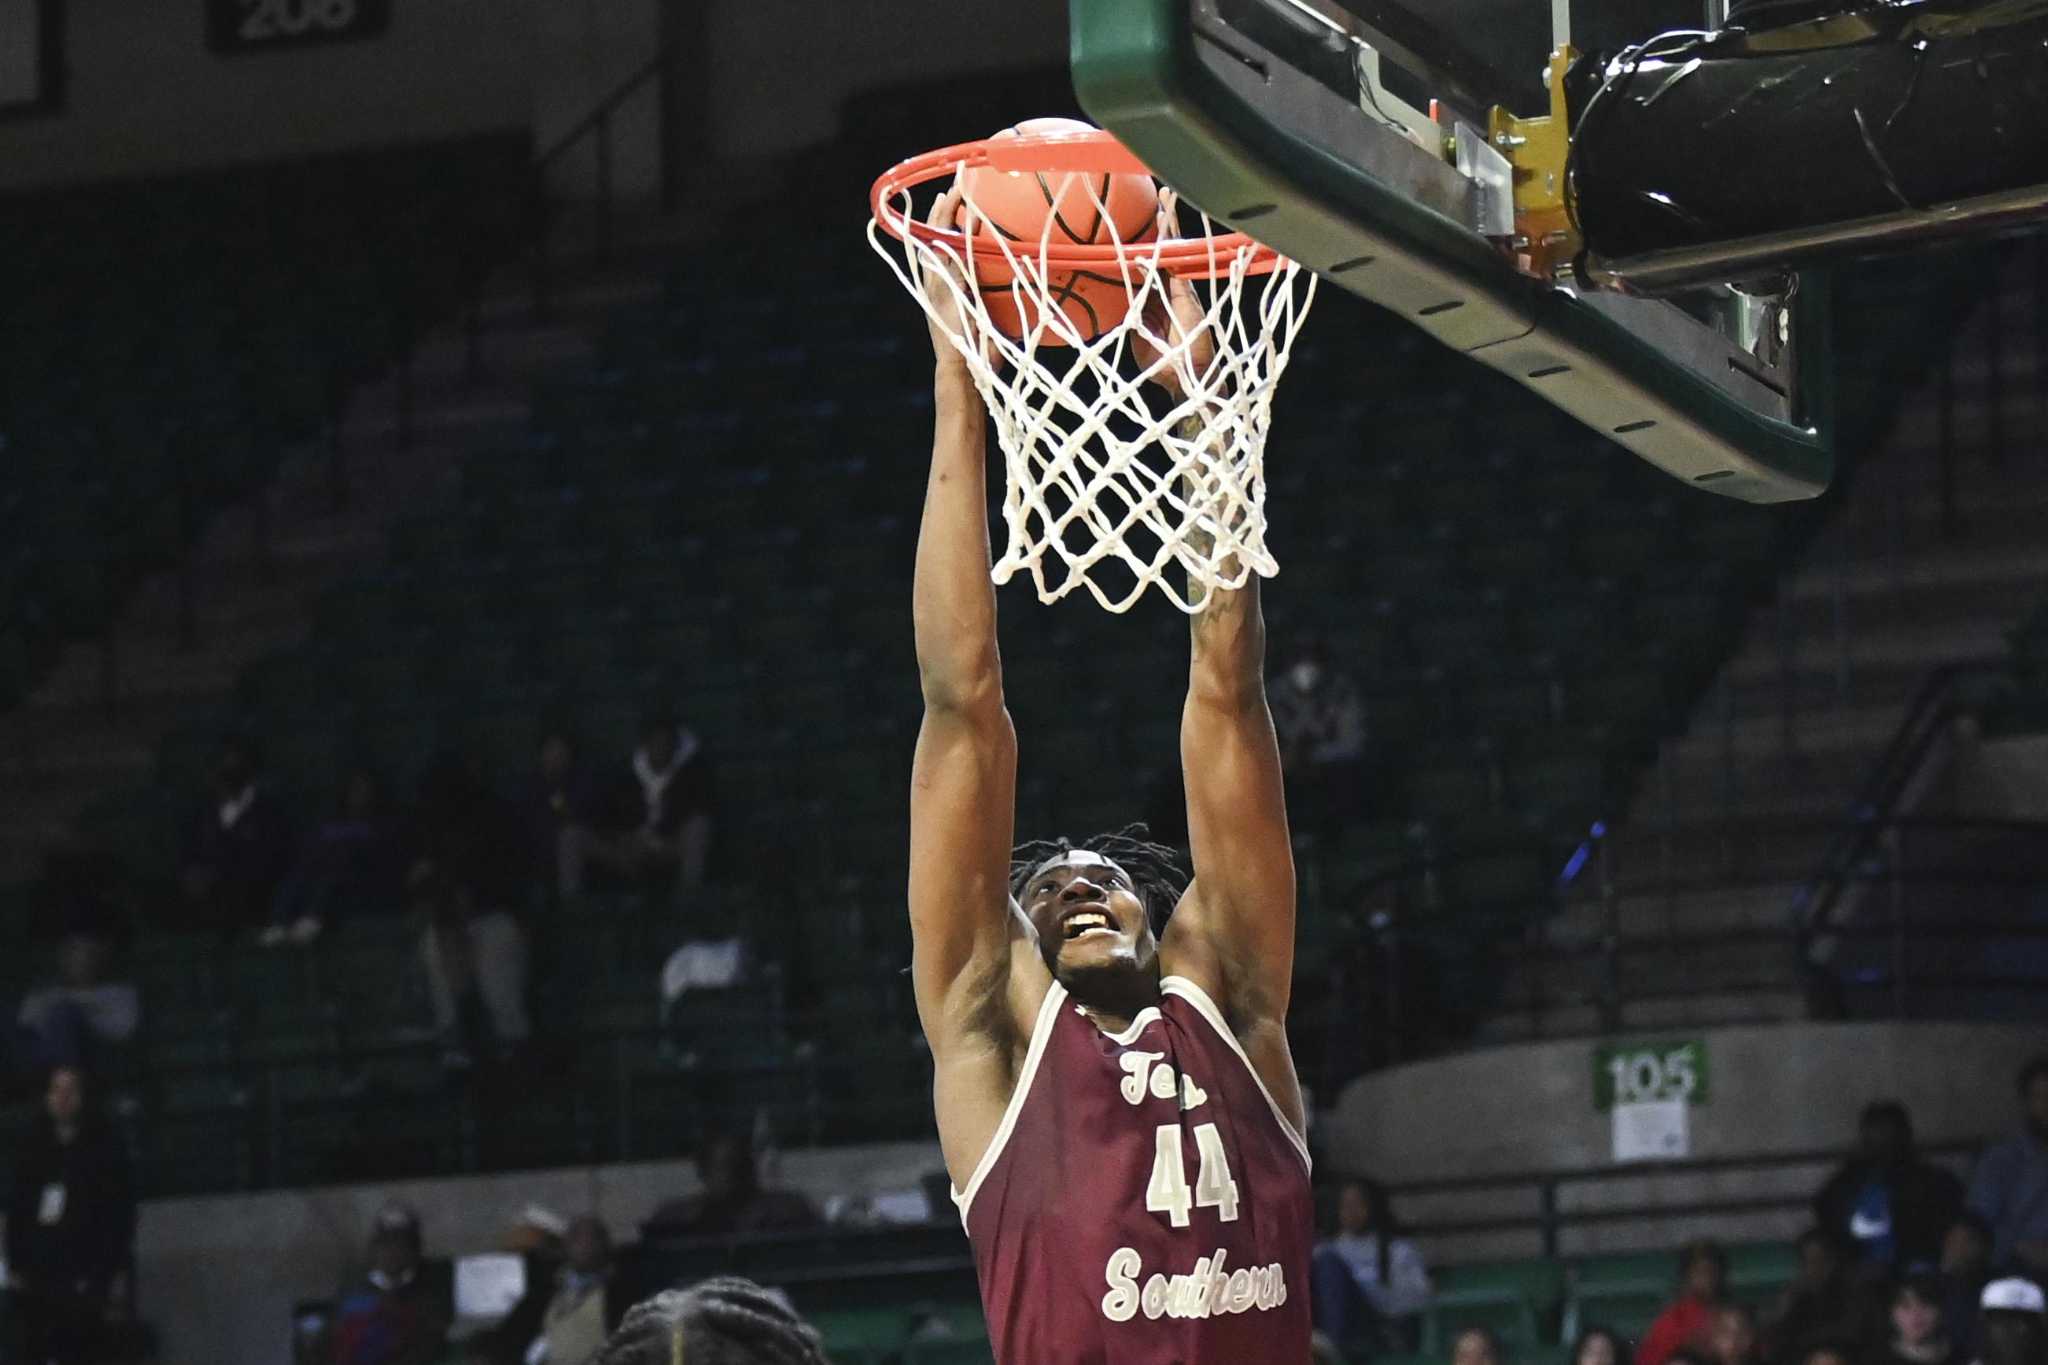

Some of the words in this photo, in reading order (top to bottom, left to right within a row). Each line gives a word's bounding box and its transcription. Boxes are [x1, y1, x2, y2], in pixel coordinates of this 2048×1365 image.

[1609, 1046, 1696, 1103] 105
[1145, 1122, 1240, 1228] 44
[1101, 1246, 1288, 1322] Southern
